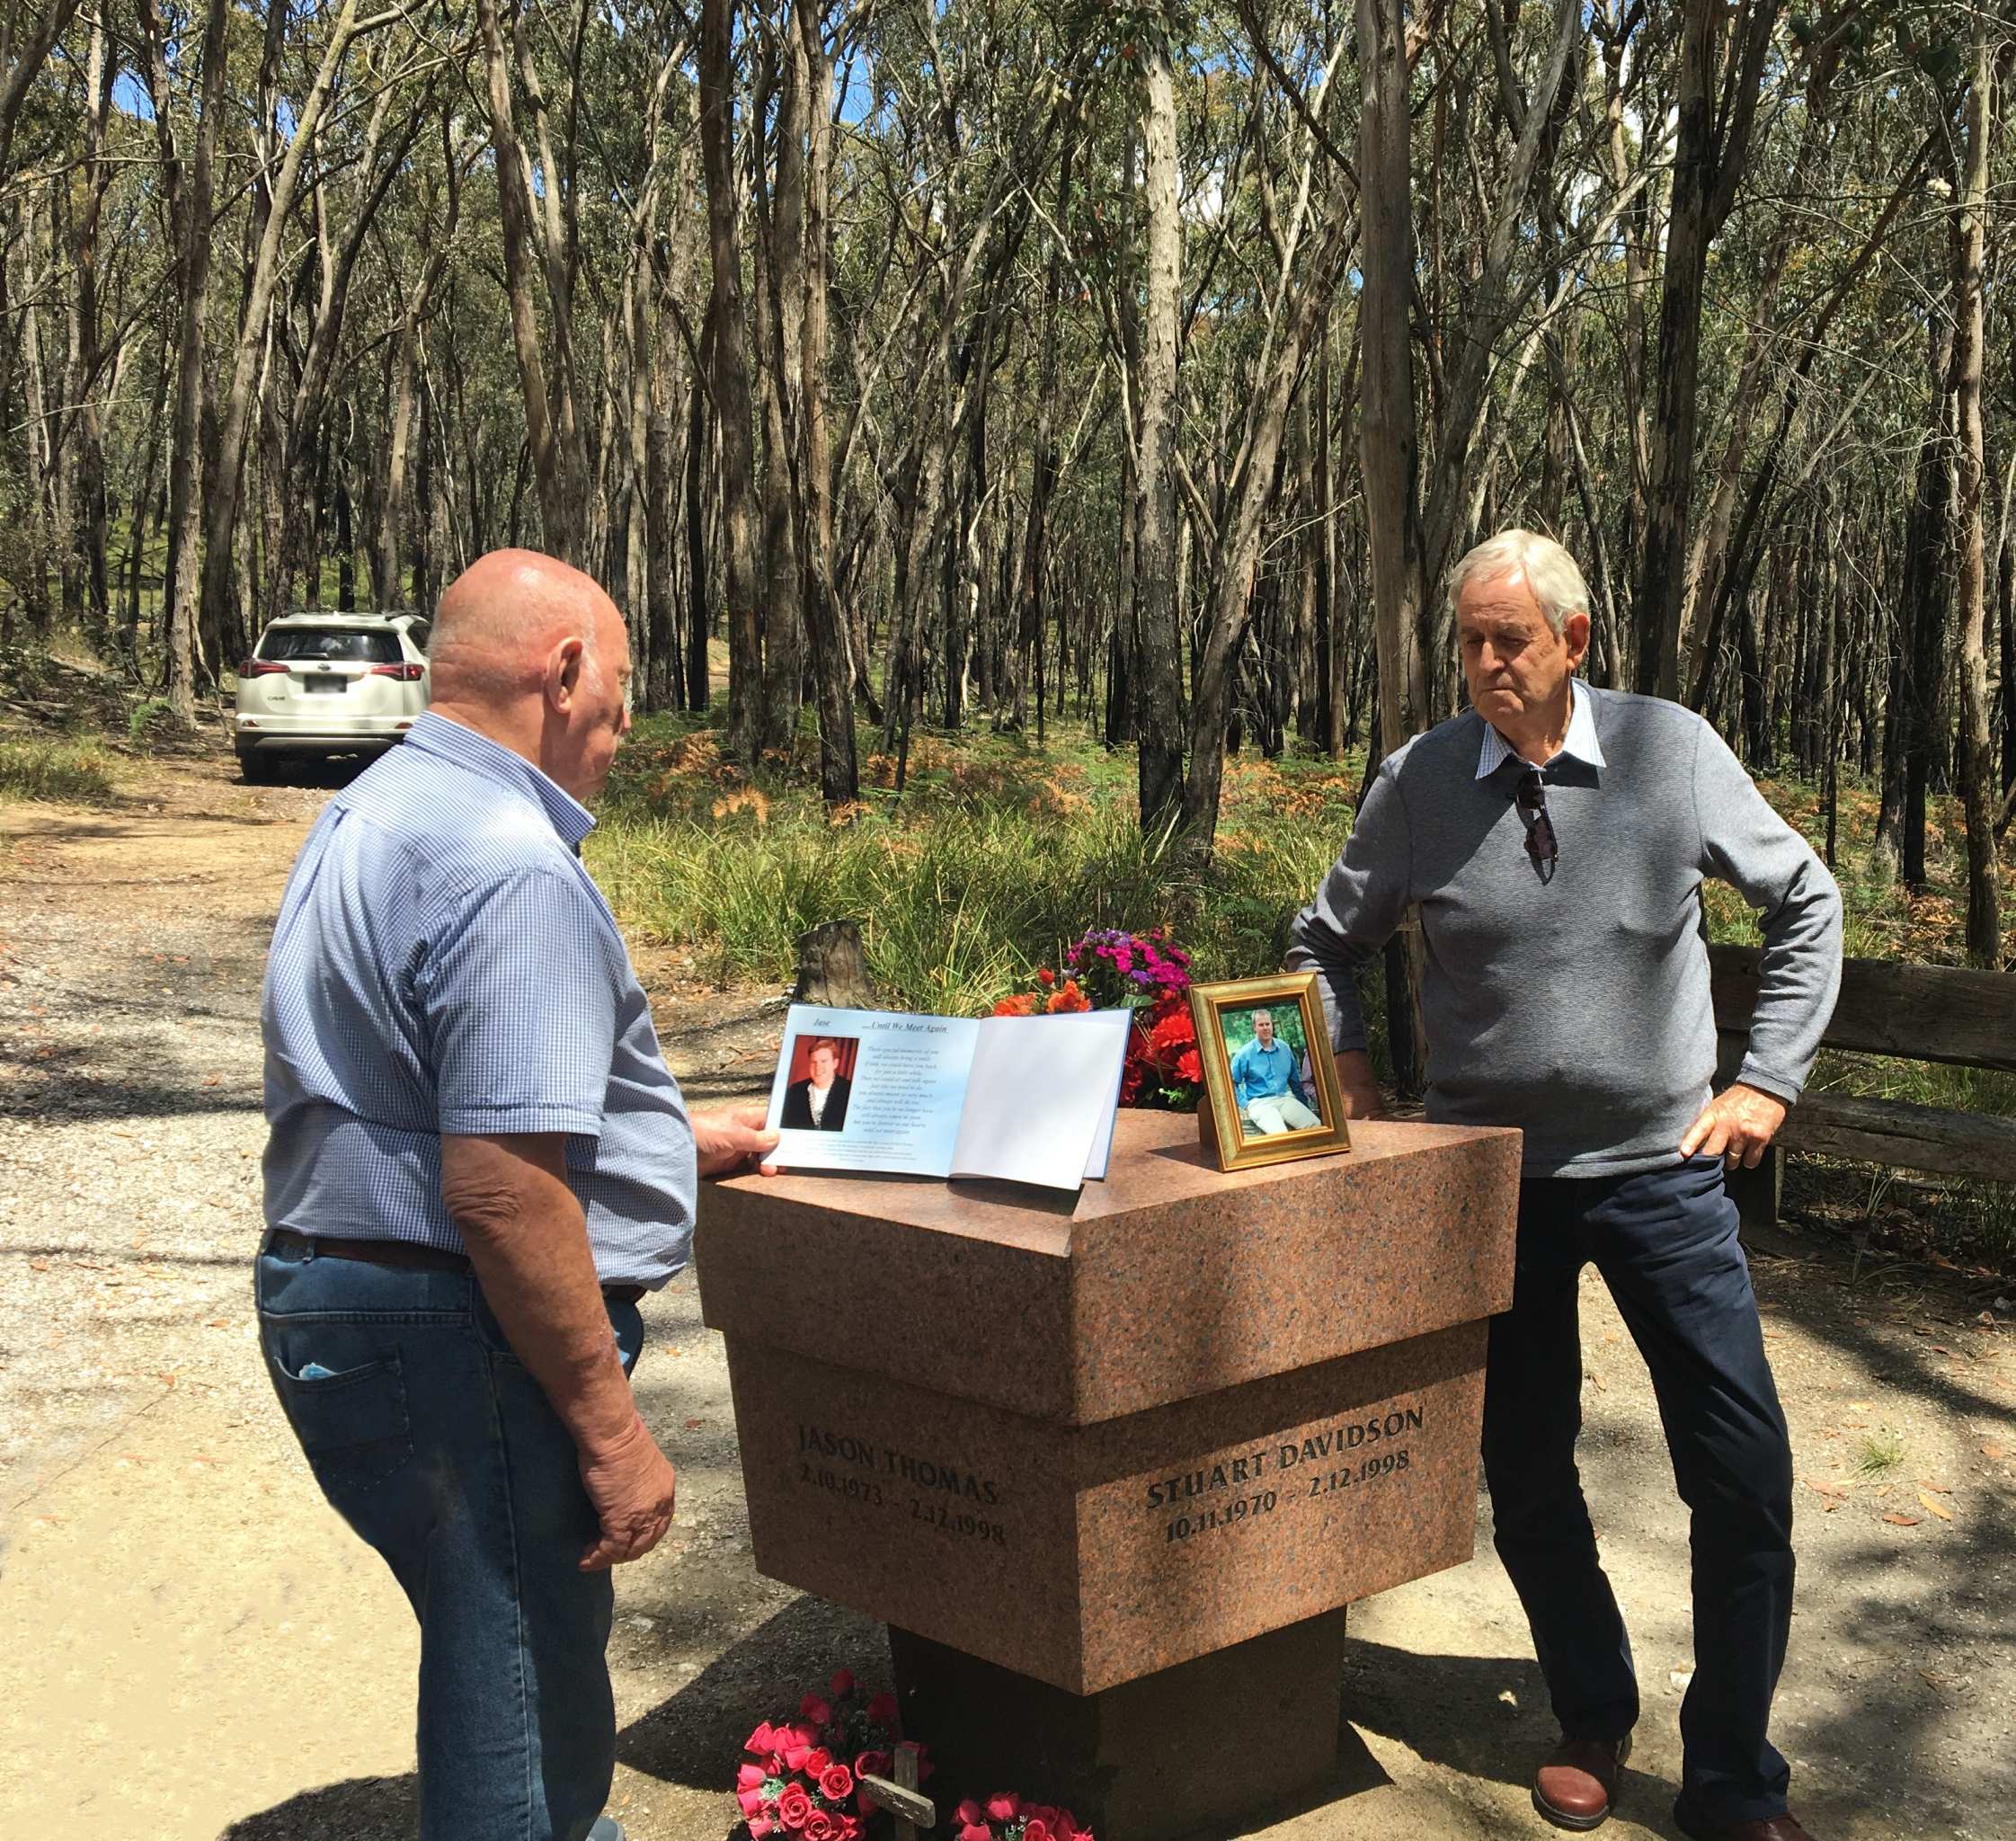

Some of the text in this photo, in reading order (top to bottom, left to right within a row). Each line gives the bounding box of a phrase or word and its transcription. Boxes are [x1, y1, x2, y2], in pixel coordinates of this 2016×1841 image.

[905, 1023, 924, 1033] Meet
[799, 1424, 999, 1506] JASON THOMAS
[801, 1463, 884, 1507] 2.10.1973
[1147, 1406, 1425, 1509] STUART DAVIDSON
[1167, 1490, 1277, 1543] 10.11.1970
[1308, 1449, 1410, 1499] 2.12.1998
